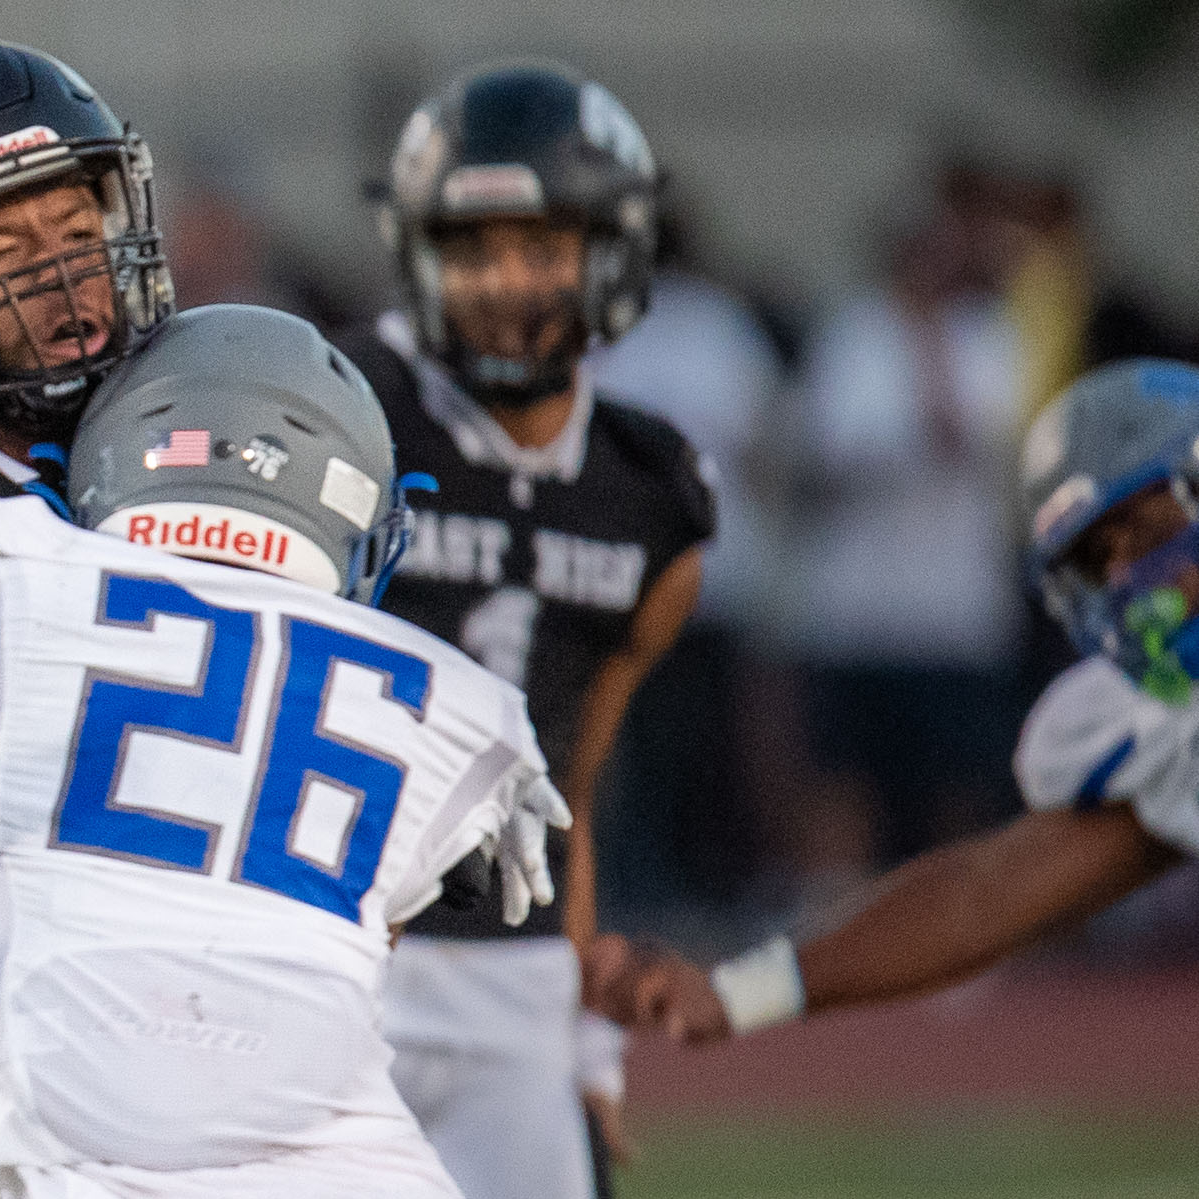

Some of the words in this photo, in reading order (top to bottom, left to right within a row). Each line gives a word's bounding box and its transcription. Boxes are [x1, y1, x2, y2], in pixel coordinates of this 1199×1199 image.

[128, 513, 289, 565] Riddell
[395, 512, 509, 583] AST
[48, 568, 433, 925] 26
